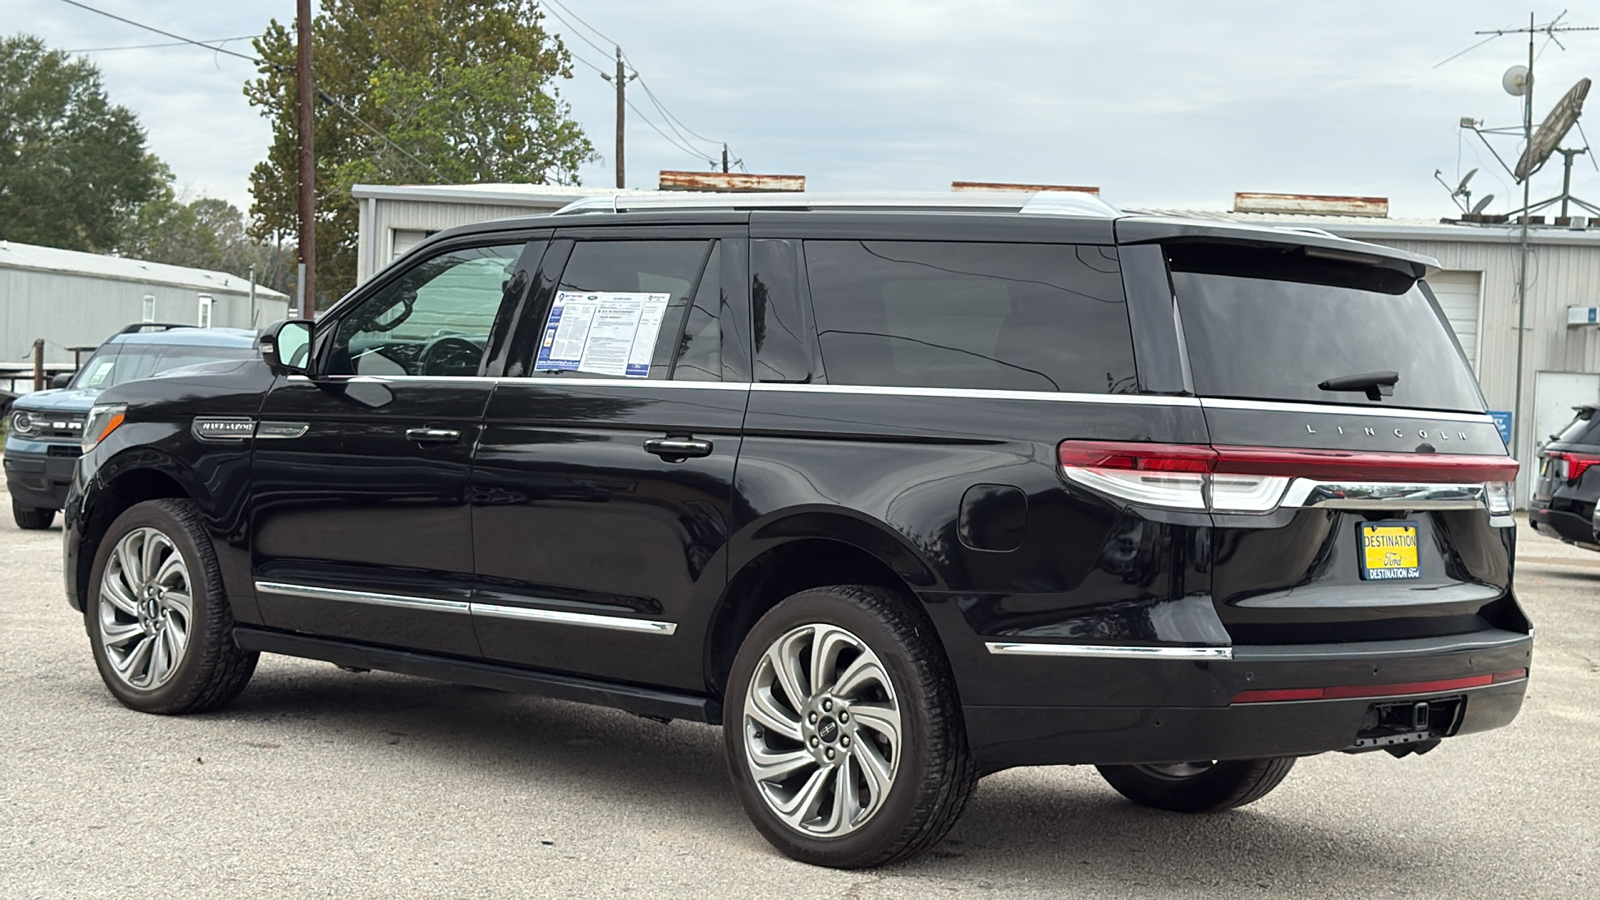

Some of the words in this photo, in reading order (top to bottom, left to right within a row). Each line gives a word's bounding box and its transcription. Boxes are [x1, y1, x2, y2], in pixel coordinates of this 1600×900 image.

[1305, 424, 1467, 441] LINCOLN
[1364, 535, 1417, 548] DESTINATION
[1383, 551, 1403, 567] Ford
[1370, 569, 1408, 579] DESTINATION
[1408, 568, 1420, 578] Ford
